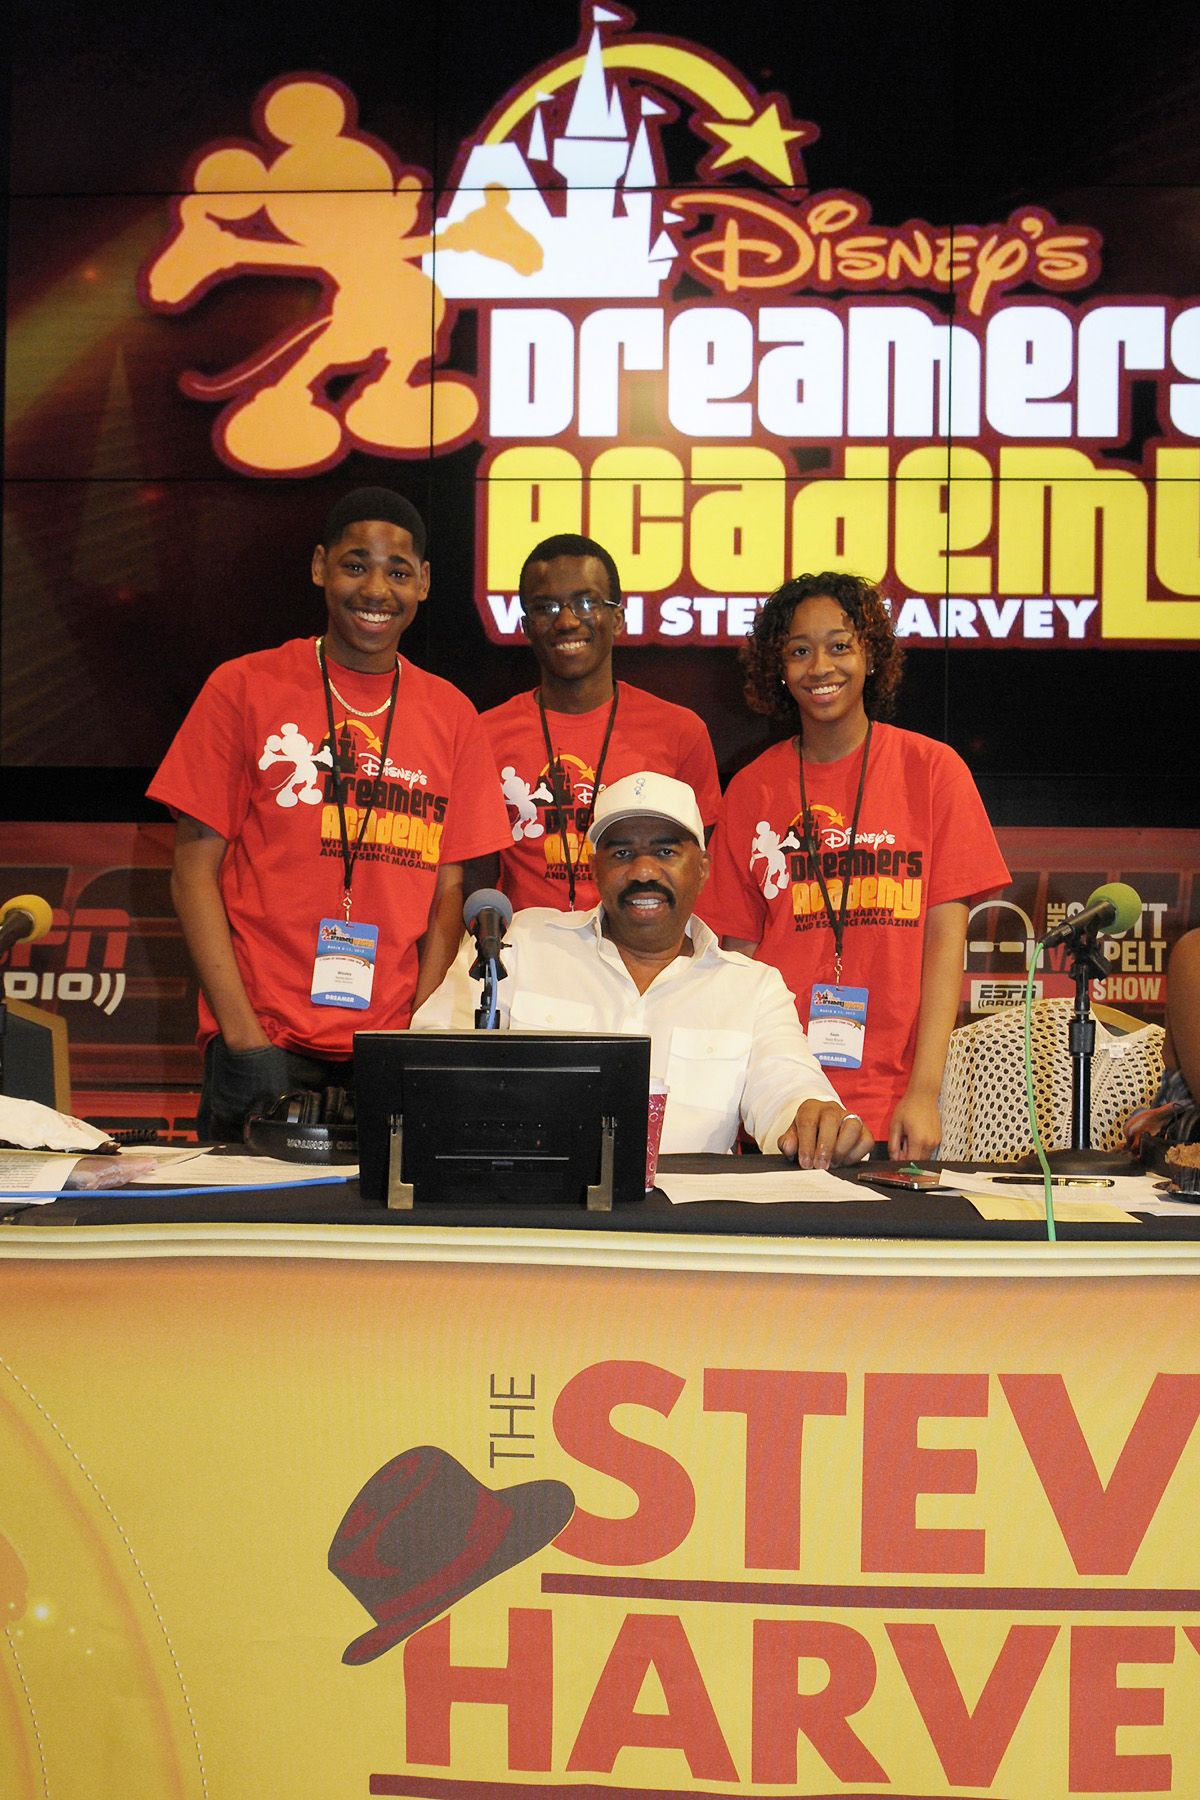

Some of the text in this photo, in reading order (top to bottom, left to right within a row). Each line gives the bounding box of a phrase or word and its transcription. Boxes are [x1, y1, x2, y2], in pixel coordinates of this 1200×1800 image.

[672, 193, 1089, 314] Disney's
[659, 596, 768, 637] STE
[881, 598, 1098, 638] ARVEY
[384, 847, 422, 860] HARVEY
[0, 908, 130, 969] PN
[860, 917, 920, 928] MAGAZINE
[980, 984, 1037, 999] ESPN
[1092, 976, 1162, 1001] SHOW
[489, 1373, 536, 1469] THE
[403, 1607, 1200, 1793] HARVE
